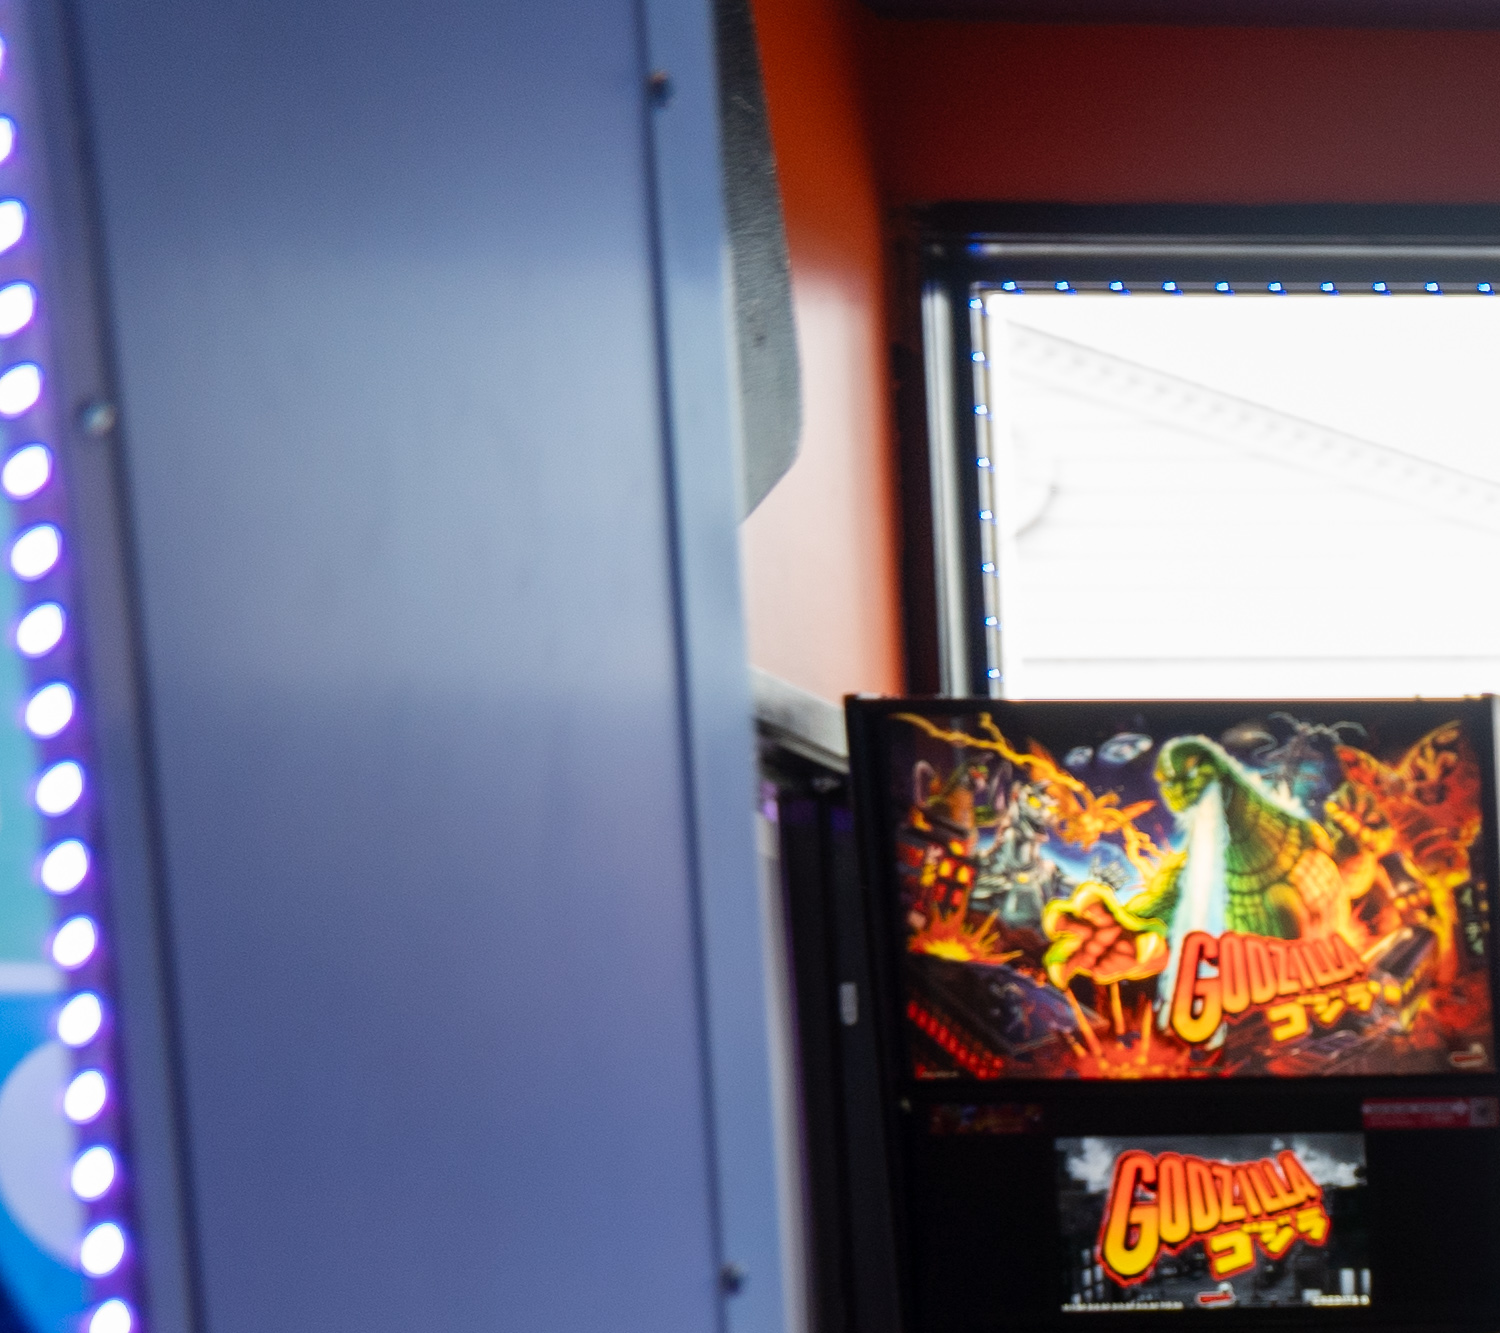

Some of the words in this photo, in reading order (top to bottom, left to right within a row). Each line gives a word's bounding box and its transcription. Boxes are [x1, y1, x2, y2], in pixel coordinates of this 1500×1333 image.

[1171, 930, 1366, 1044] GODZILLA
[1101, 1151, 1322, 1278] GODZILLA
[1209, 1205, 1327, 1276] ゴジラ
